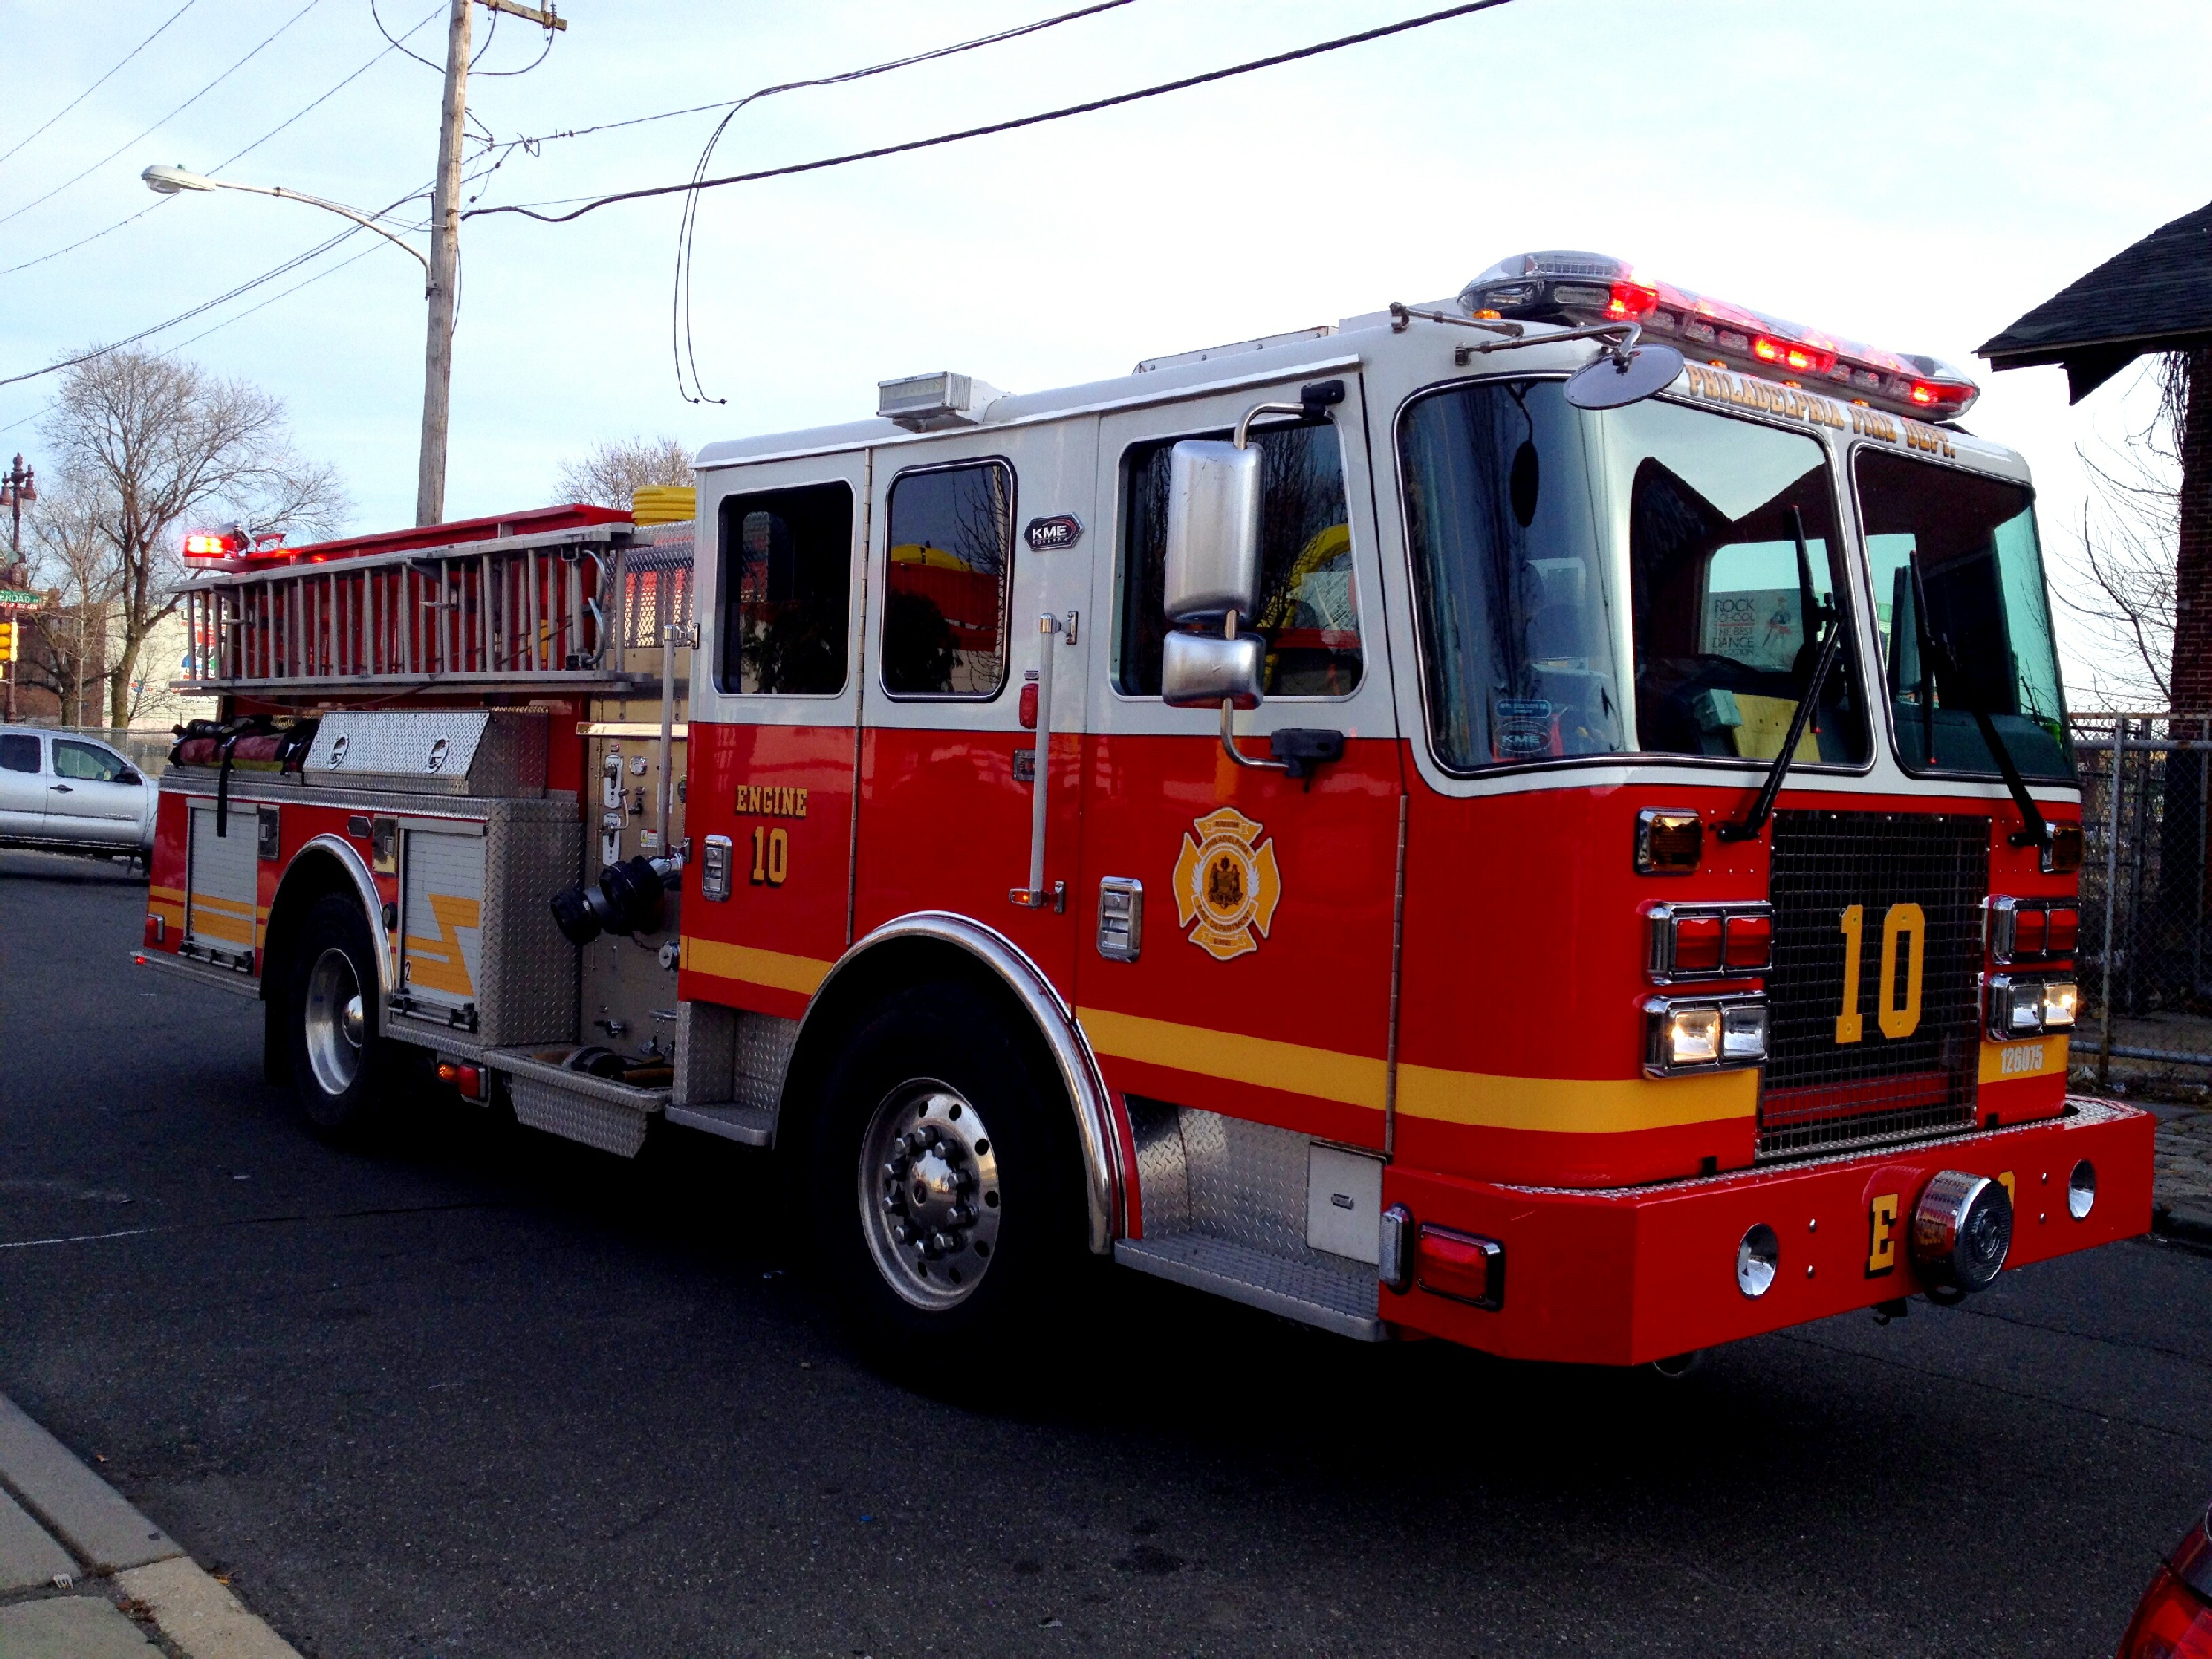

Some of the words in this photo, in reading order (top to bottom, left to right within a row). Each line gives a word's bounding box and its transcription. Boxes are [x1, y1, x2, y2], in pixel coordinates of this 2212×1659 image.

[1686, 365, 1845, 430] PHILADELPHIA
[1848, 405, 1897, 443] FIRE
[1904, 419, 1956, 459] DEPT.
[1032, 525, 1068, 539] KME
[1714, 597, 1755, 613] ROCK
[1712, 636, 1755, 648] DANCE
[1502, 735, 1540, 744] KME
[736, 784, 808, 818] ENGINE
[752, 826, 788, 885] 10
[1835, 902, 1926, 1044] 10
[2001, 1044, 2044, 1074] 126075
[1869, 1194, 1899, 1271] E
